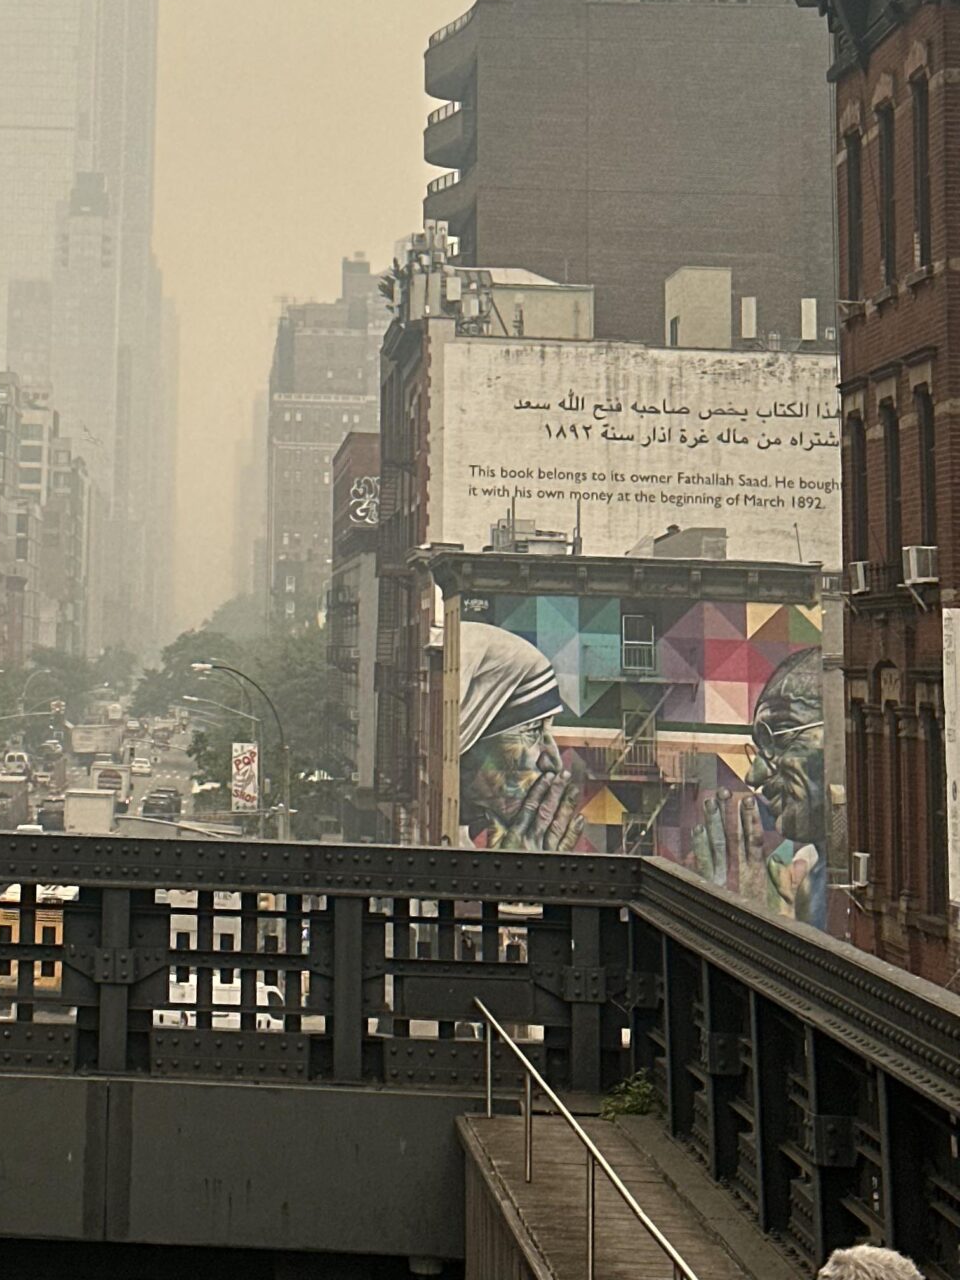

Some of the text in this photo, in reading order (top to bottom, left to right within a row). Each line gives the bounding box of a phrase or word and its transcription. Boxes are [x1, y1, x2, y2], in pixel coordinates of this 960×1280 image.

[513, 399, 550, 410] سعد
[592, 397, 622, 420] فتح
[630, 398, 690, 418] صاحبه
[698, 402, 748, 422] يخص
[756, 401, 809, 424] الكتاب
[545, 423, 592, 440] ١٨٩٢
[601, 423, 634, 441] سنة
[640, 426, 671, 447] اذار
[678, 428, 709, 448] غرة
[716, 428, 749, 444] ماله
[757, 433, 782, 449] من
[469, 464, 495, 478] This
[500, 466, 534, 479] book
[538, 467, 587, 484] belongs
[592, 471, 606, 481] to
[611, 470, 625, 482] its
[630, 475, 672, 484] owner
[677, 472, 734, 487] Fathallah
[738, 474, 772, 488] Saad.
[775, 476, 794, 489] He
[468, 484, 826, 510] it with his own money at the beginning of March 1892.
[234, 751, 256, 771] POP
[233, 789, 257, 802] SHOP
